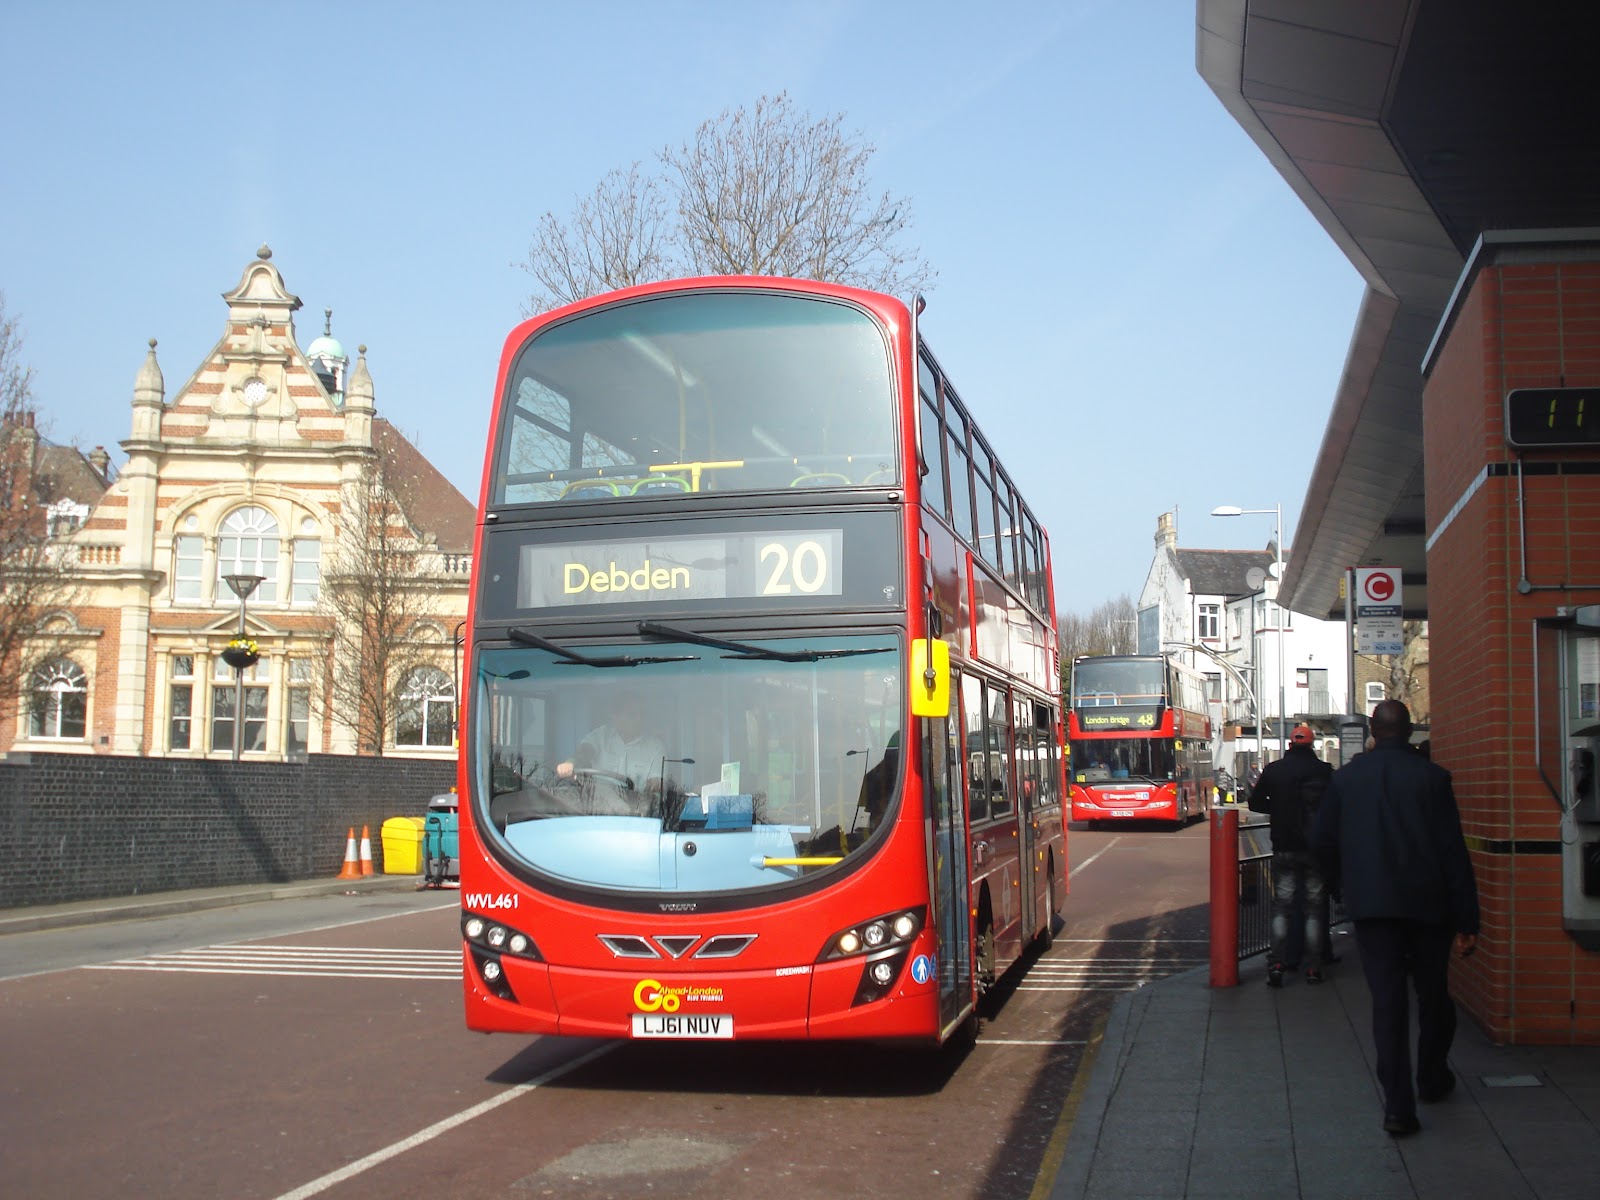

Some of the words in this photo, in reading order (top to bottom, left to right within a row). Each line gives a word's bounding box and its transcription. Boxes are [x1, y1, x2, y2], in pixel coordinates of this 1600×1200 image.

[760, 541, 827, 595] 20
[564, 560, 690, 595] Debden
[1085, 716, 1109, 725] London
[1110, 716, 1130, 726] Bridge
[1137, 714, 1154, 726] 48
[466, 893, 519, 910] WVL461
[659, 903, 697, 911] VOLVO
[633, 979, 680, 1012] Go
[643, 1017, 682, 1034] LJ61
[687, 1017, 721, 1034] NUV
